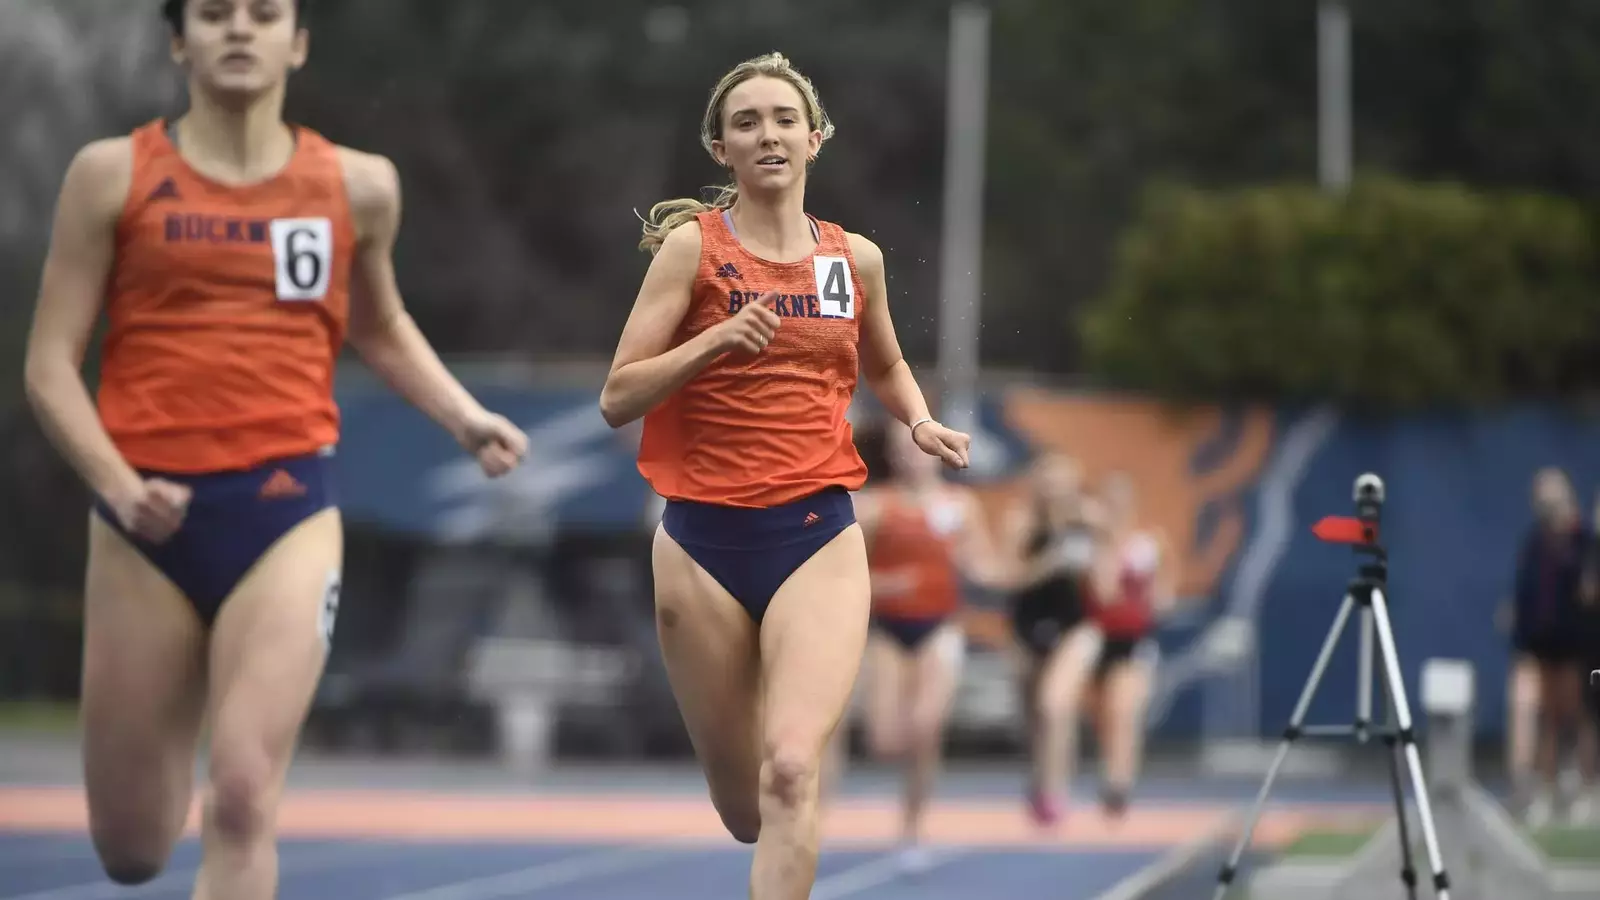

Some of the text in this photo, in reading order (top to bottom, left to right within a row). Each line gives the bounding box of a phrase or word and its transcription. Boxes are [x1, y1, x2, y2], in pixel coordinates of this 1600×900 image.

[286, 228, 321, 290] 6
[728, 289, 846, 318] BUKNE
[822, 261, 850, 313] 4
